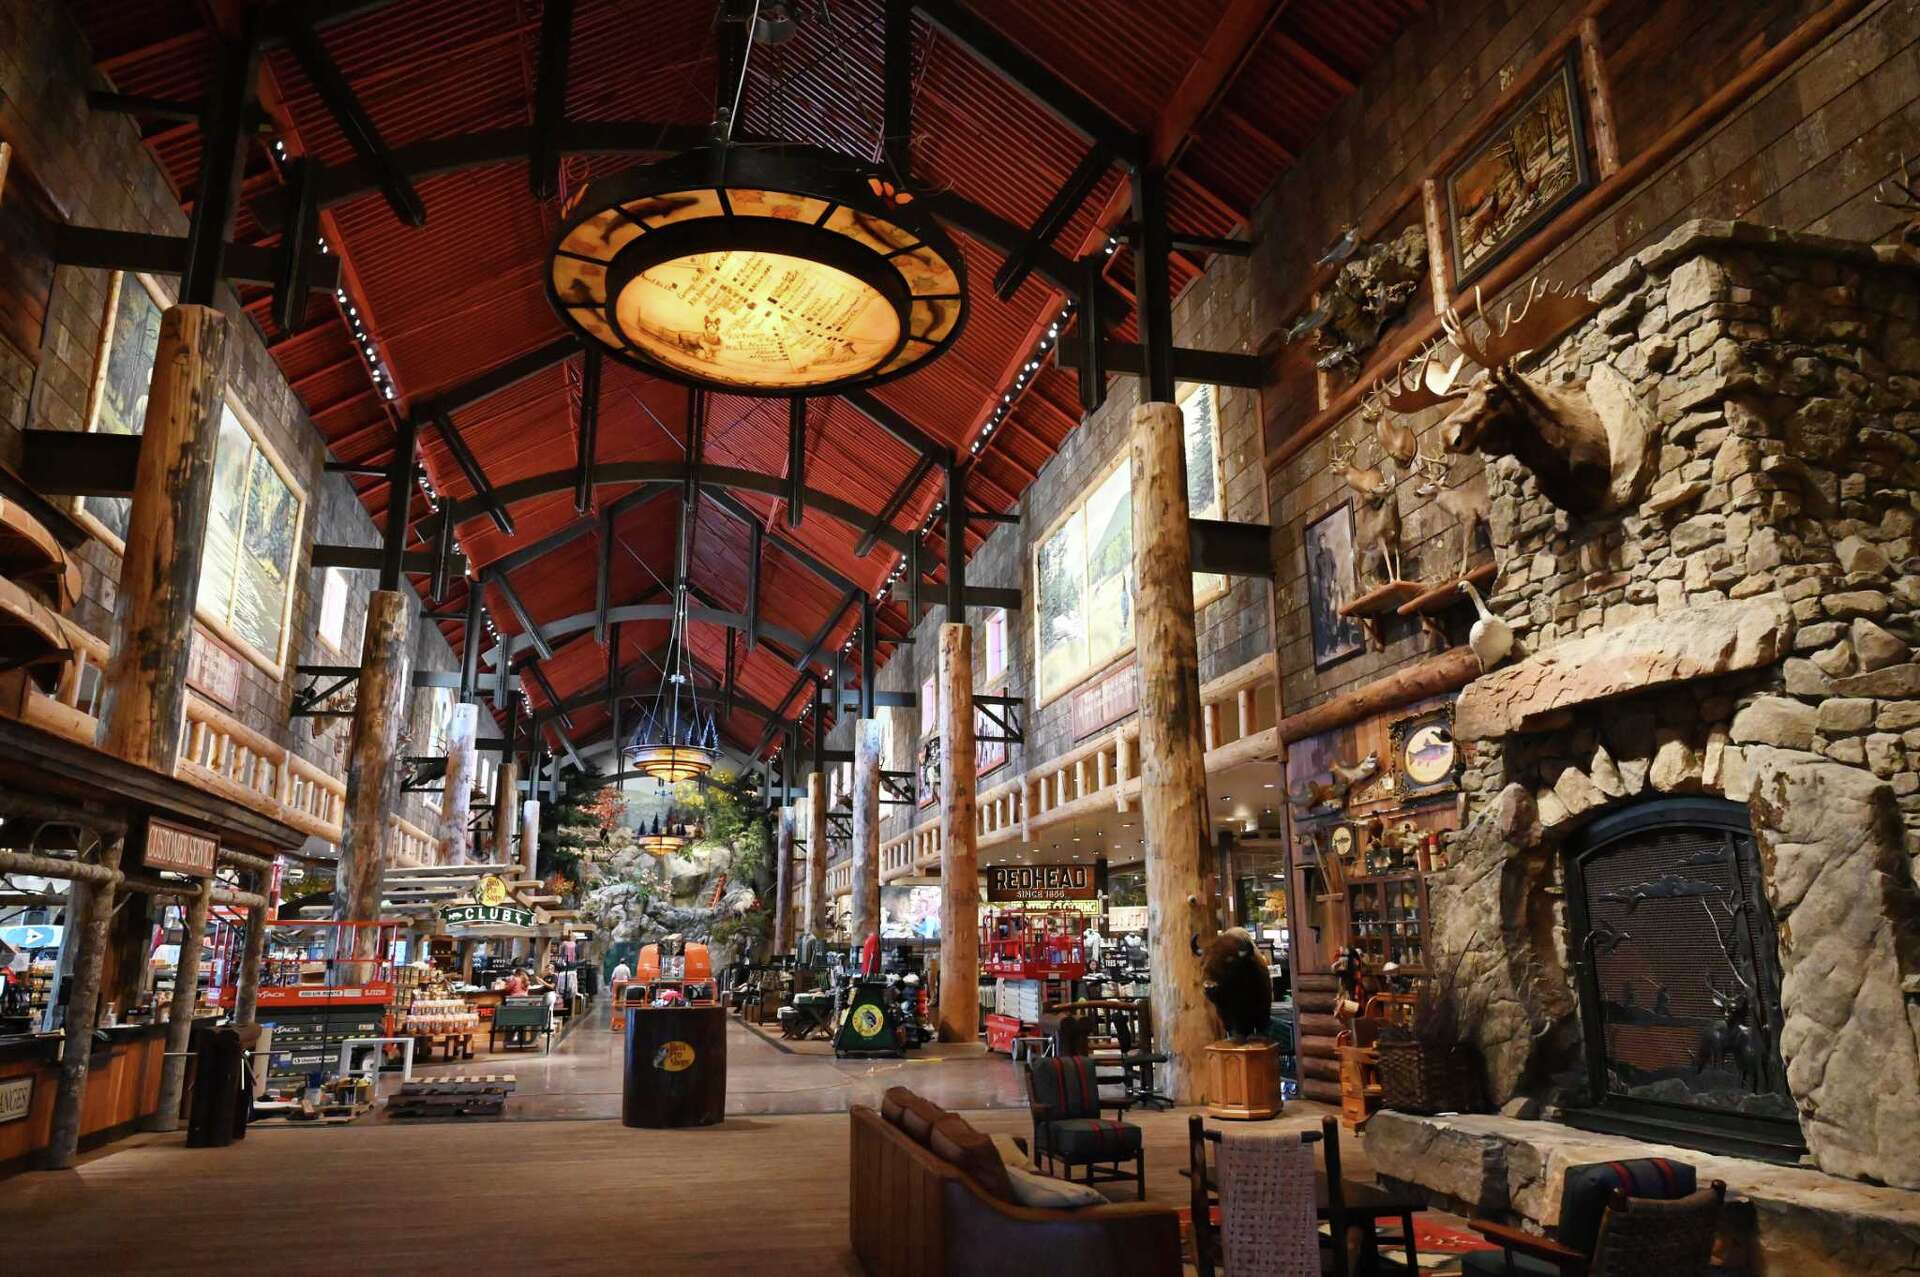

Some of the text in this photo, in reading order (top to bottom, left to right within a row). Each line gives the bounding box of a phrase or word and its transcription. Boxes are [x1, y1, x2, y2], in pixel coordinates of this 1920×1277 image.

[147, 825, 216, 869] CUSTOMER SERVICE
[995, 867, 1088, 890] REDHEAD
[1017, 889, 1042, 899] SINCE
[465, 908, 511, 921] CLUB
